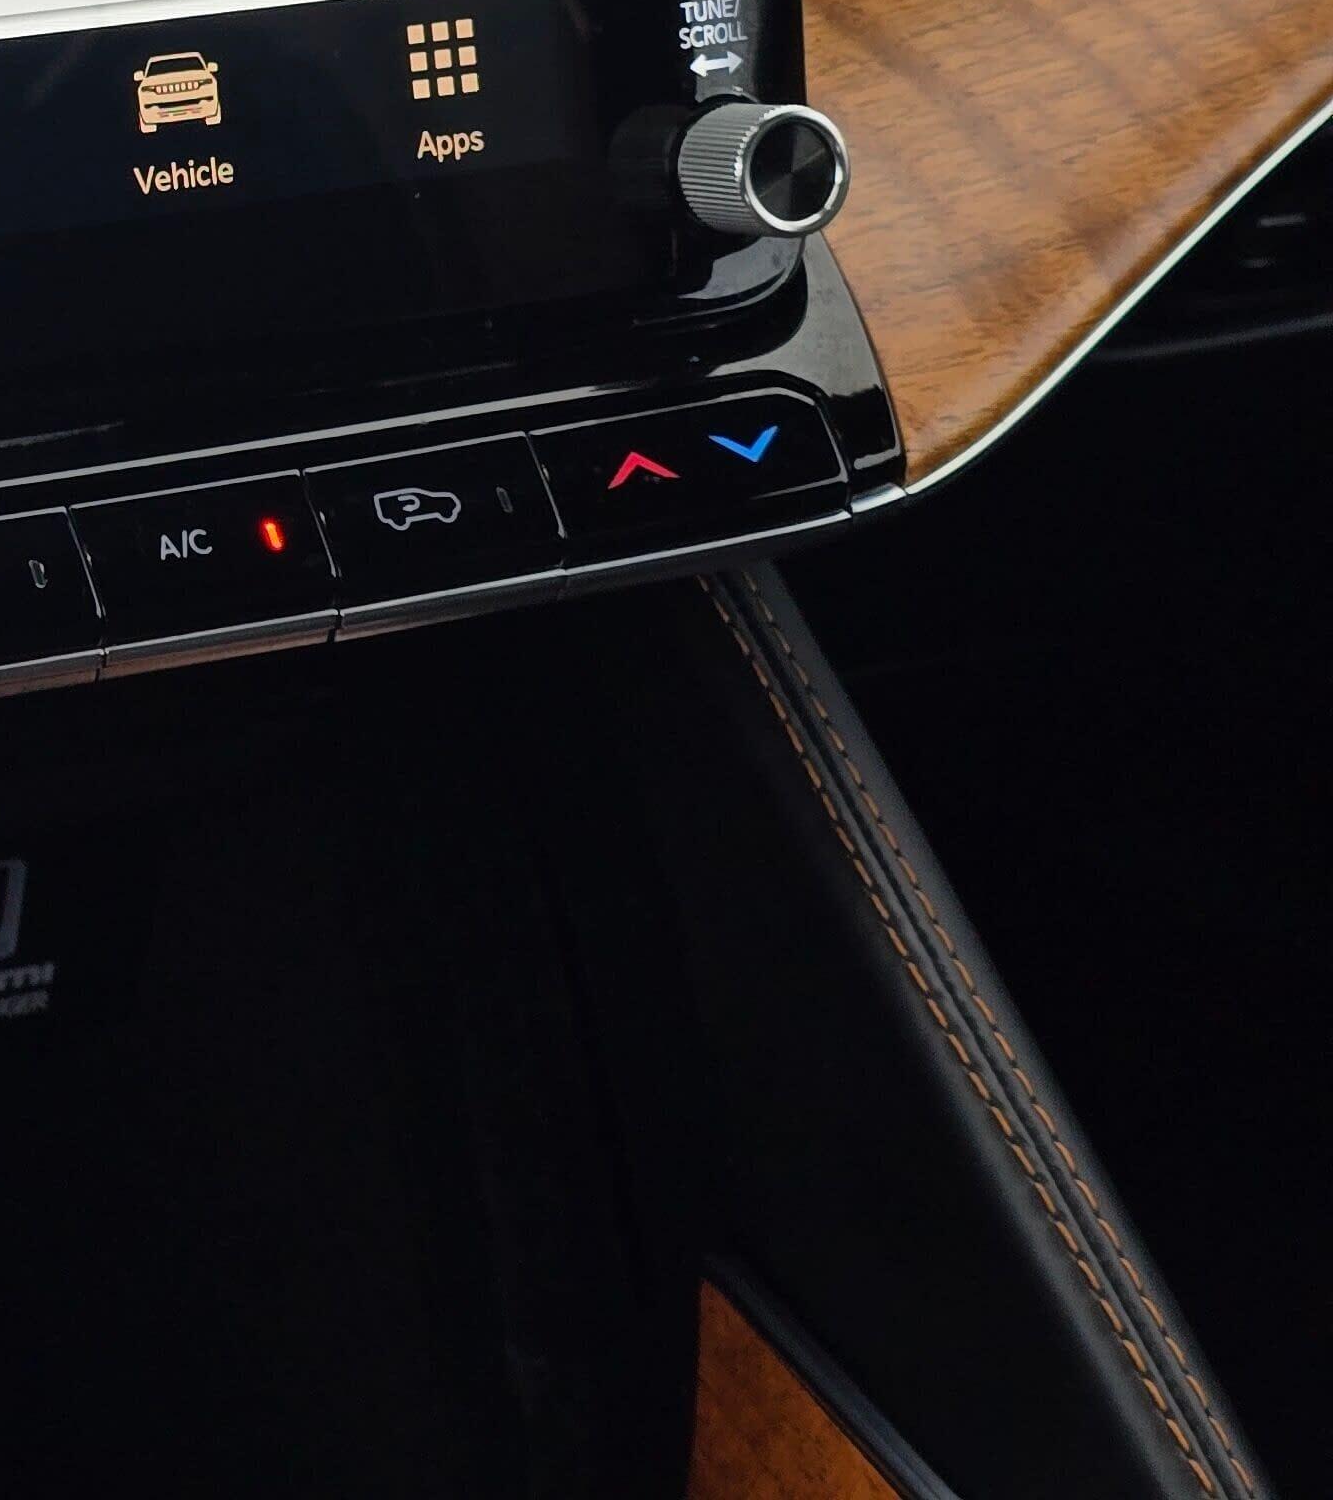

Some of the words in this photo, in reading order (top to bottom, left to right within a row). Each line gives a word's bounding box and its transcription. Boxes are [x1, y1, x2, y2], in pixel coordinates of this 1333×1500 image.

[679, 21, 749, 49] SCROLL
[417, 129, 485, 163] Apps
[134, 160, 235, 194] Vehicle
[159, 529, 213, 561] A/C
